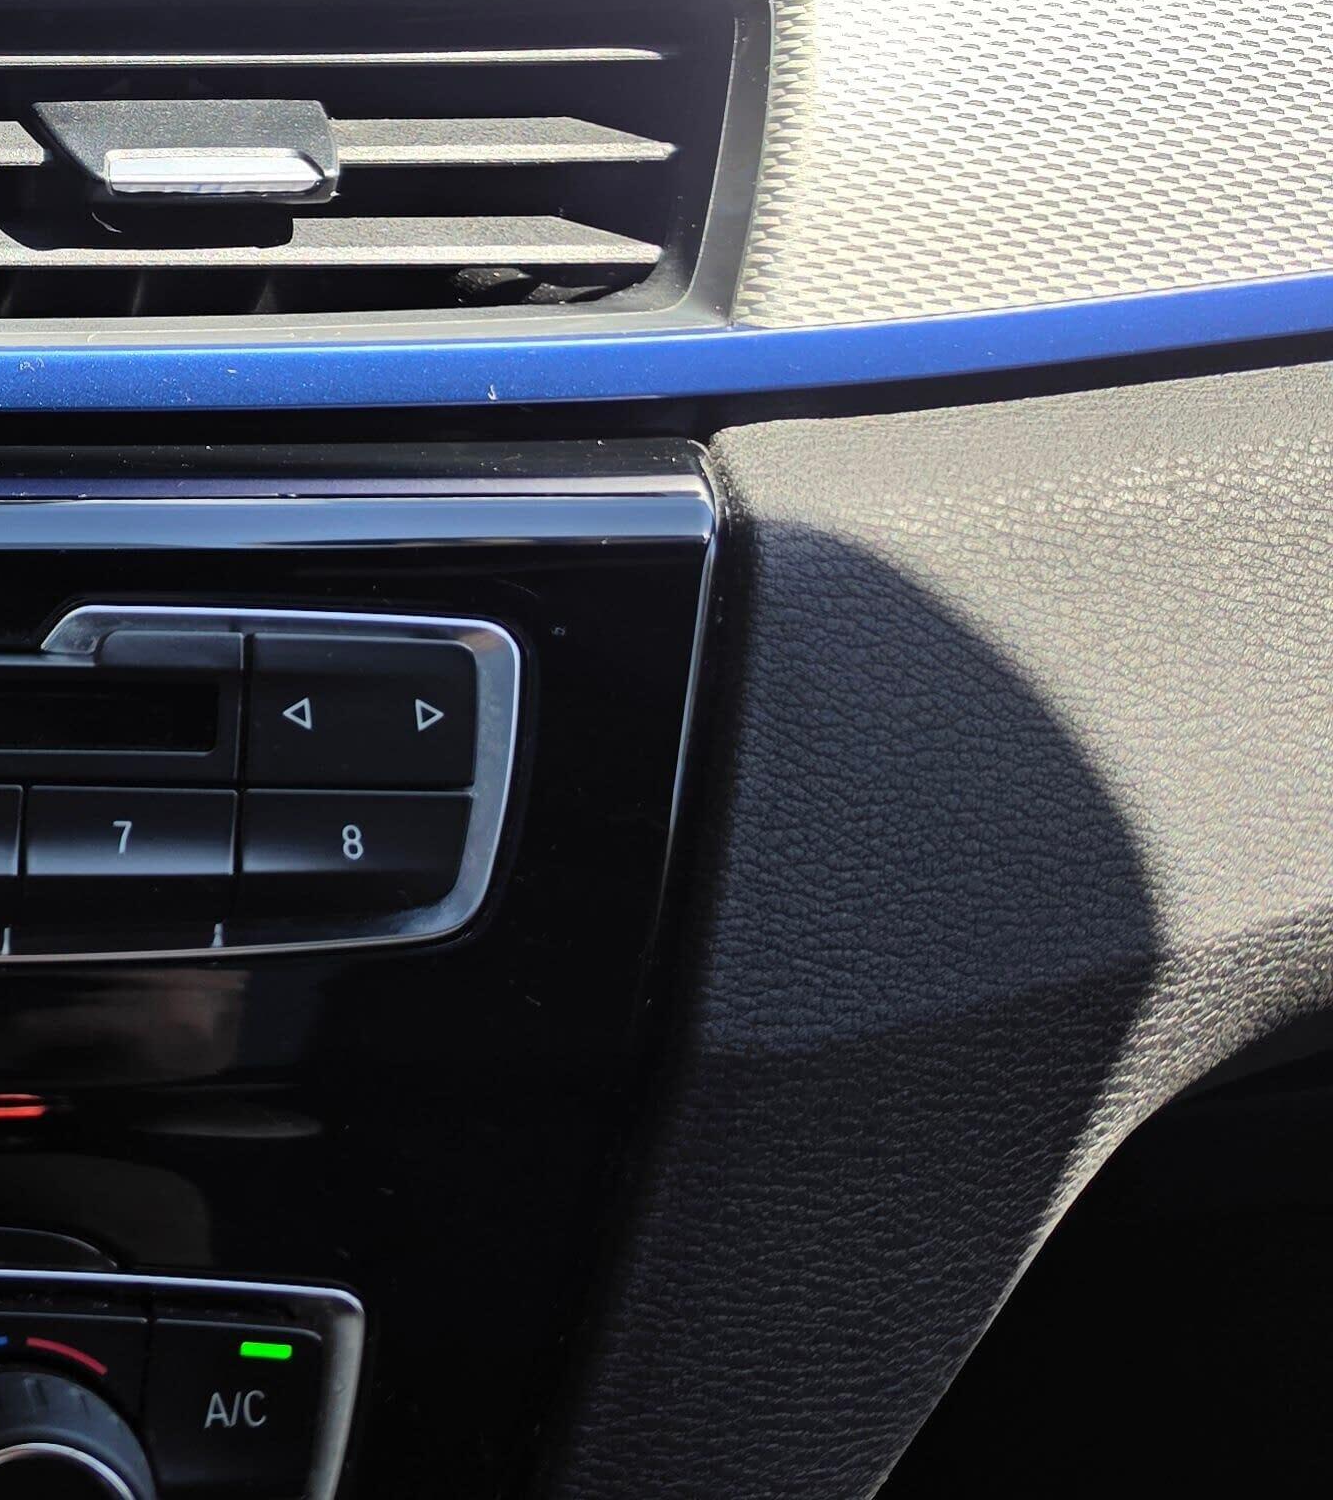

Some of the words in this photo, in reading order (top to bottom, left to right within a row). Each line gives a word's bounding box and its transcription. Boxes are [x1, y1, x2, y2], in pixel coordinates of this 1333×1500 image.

[112, 820, 133, 855] 7
[341, 824, 364, 861] 8
[203, 1389, 267, 1430] A/C
